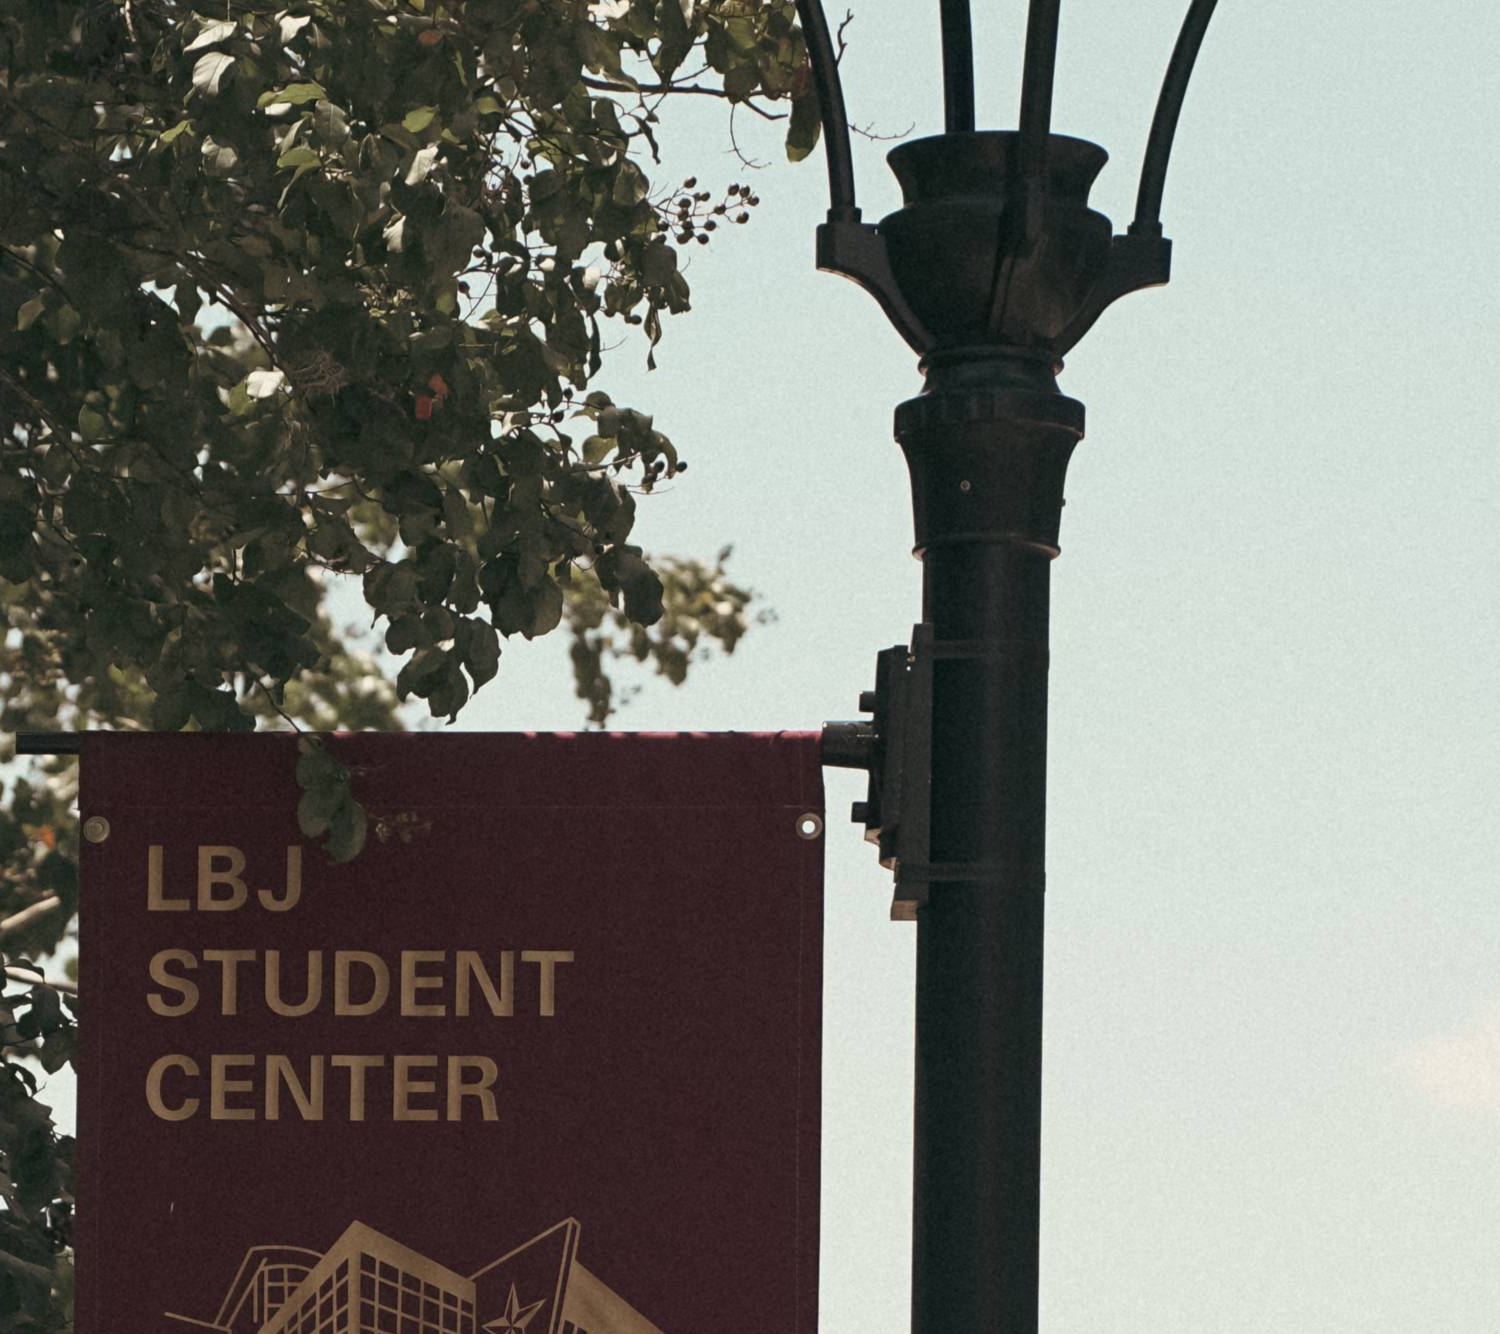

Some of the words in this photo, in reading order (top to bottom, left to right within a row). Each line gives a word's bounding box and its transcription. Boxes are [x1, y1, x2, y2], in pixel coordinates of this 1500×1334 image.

[147, 844, 302, 912] LBJ
[146, 948, 575, 1017] STUDENT
[145, 1053, 500, 1122] CENTER
